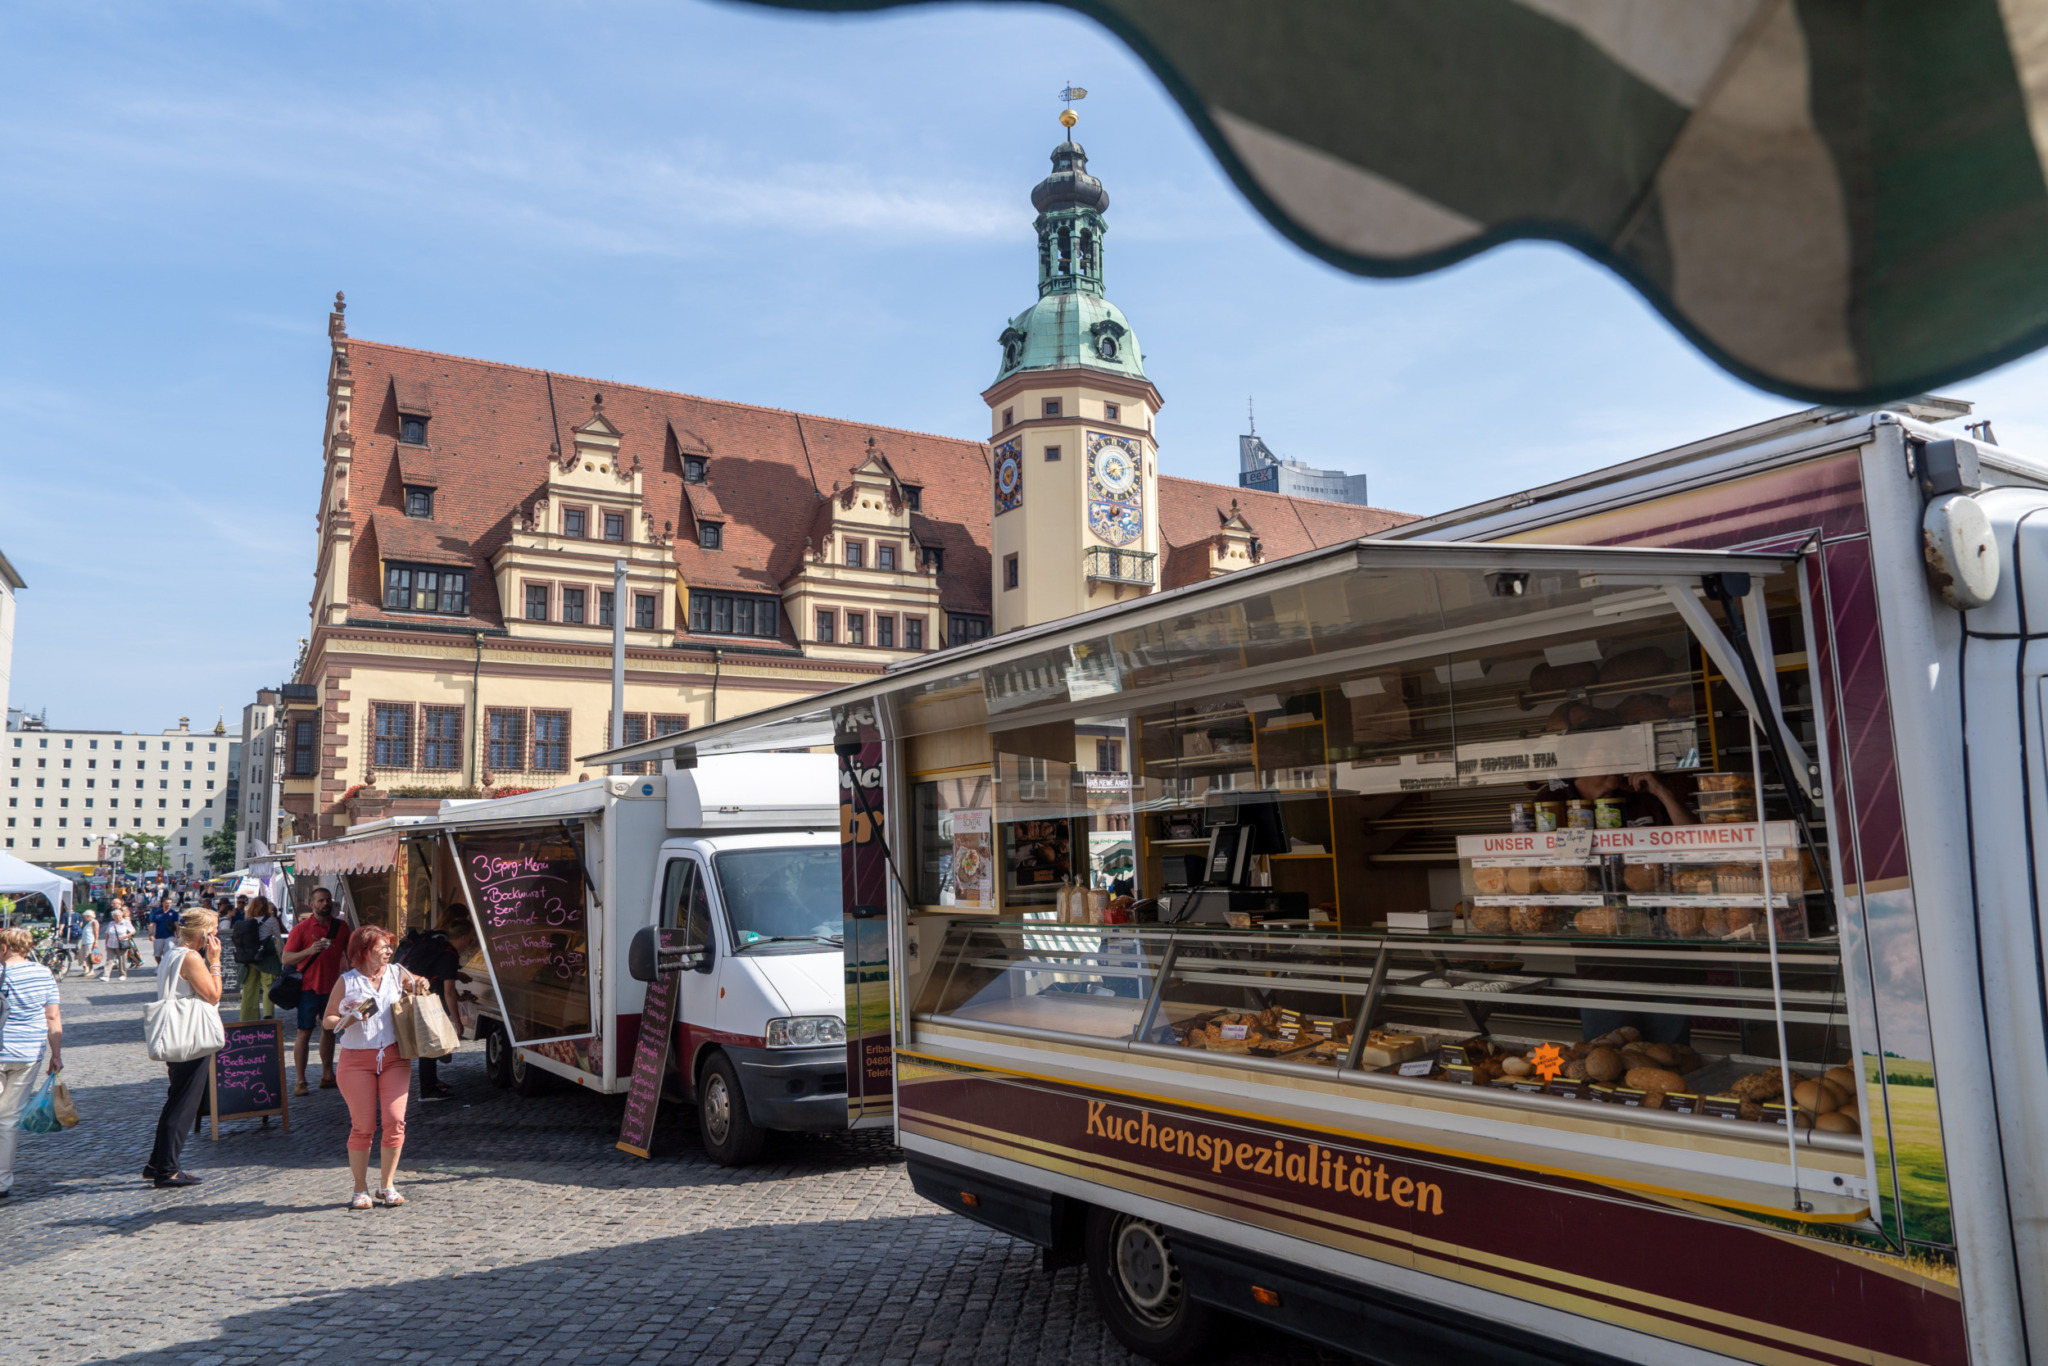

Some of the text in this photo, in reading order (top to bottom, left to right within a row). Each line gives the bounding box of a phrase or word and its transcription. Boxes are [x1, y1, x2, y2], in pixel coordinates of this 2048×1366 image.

[1484, 837, 1534, 851] UNSER
[1546, 833, 1634, 849] BCHEN
[1650, 828, 1755, 846] SORTIMENT
[487, 885, 547, 903] Bockwurst
[494, 901, 521, 917] Senf
[220, 1053, 267, 1067] Bockwurst
[224, 1066, 262, 1078] Semmel
[866, 1068, 893, 1077] Telefo
[224, 1076, 250, 1090] Senf
[1086, 1099, 1444, 1216] Kuchenspezialitäten
